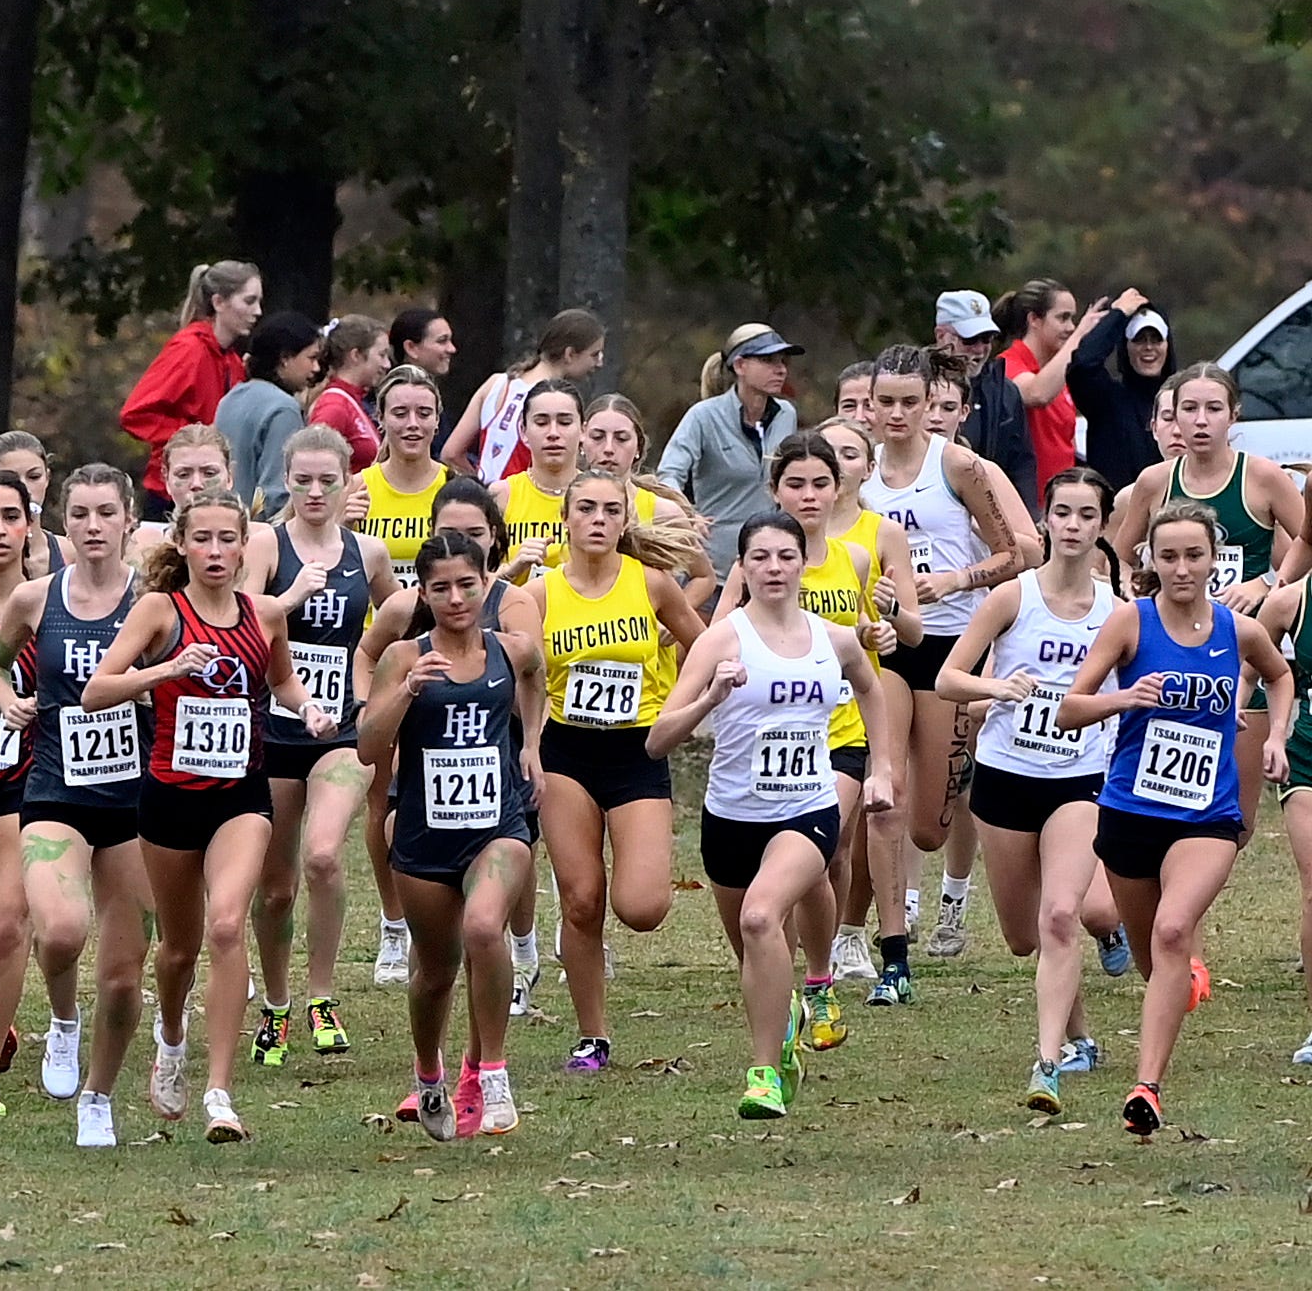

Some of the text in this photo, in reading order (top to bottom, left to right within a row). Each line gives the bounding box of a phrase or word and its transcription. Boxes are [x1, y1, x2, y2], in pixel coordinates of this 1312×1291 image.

[508, 522, 562, 546] HUTCH
[552, 616, 649, 656] HUTCHISON
[1040, 640, 1088, 665] CPA
[575, 664, 601, 677] TSSAA
[602, 667, 627, 679] STATE
[295, 666, 341, 701] 216
[769, 681, 824, 704] CPA
[1030, 687, 1054, 700] SSAA
[1157, 670, 1235, 716] GPS
[571, 678, 635, 714] 1218
[67, 714, 95, 725] TSSAA
[96, 711, 120, 723] STATE
[184, 705, 211, 715] TSSAA
[69, 725, 135, 762] 1215
[182, 721, 245, 754] 1310
[762, 730, 788, 741] TSSAA
[1154, 726, 1181, 741] TSSAA
[1013, 737, 1080, 758] CHAMPIONSHIPS
[70, 760, 137, 777] CHAMPIONSHIPS
[178, 756, 246, 770] CHAMPIONSHIPS
[430, 758, 458, 768] TSSAA
[459, 757, 484, 767] STATE
[759, 745, 818, 778] 1161
[1145, 744, 1214, 787] 1206
[432, 772, 497, 806] 1214
[755, 781, 822, 792] CHAMPIONSHIPS
[1140, 778, 1208, 802] CHAMPIONSHIPS
[432, 809, 497, 821] CHAMPIONSHIPS
